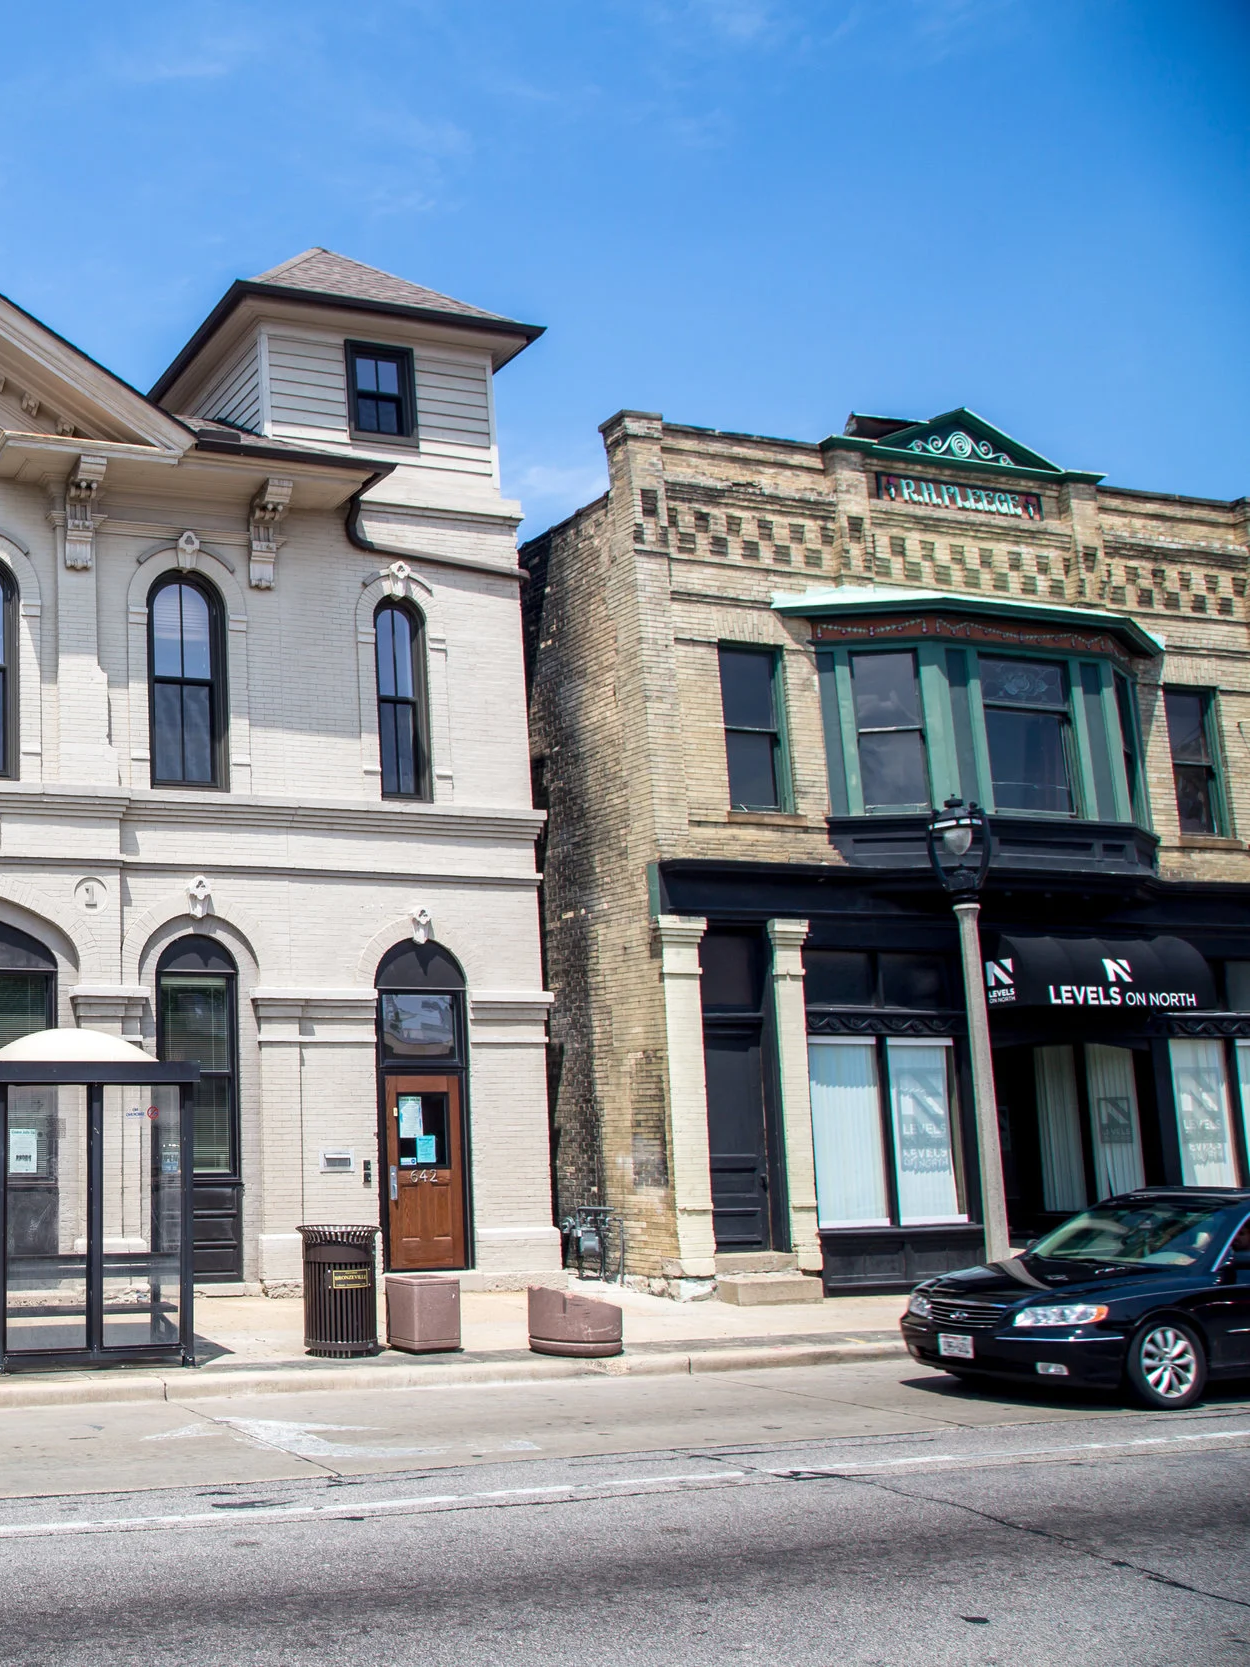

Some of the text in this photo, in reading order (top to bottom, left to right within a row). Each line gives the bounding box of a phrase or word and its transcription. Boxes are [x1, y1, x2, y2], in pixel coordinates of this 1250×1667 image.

[988, 987, 1016, 998] LEVELS
[1049, 985, 1198, 1007] LEVELS ON NORTH
[998, 995, 1017, 1003] NORTH
[410, 1169, 438, 1183] 642
